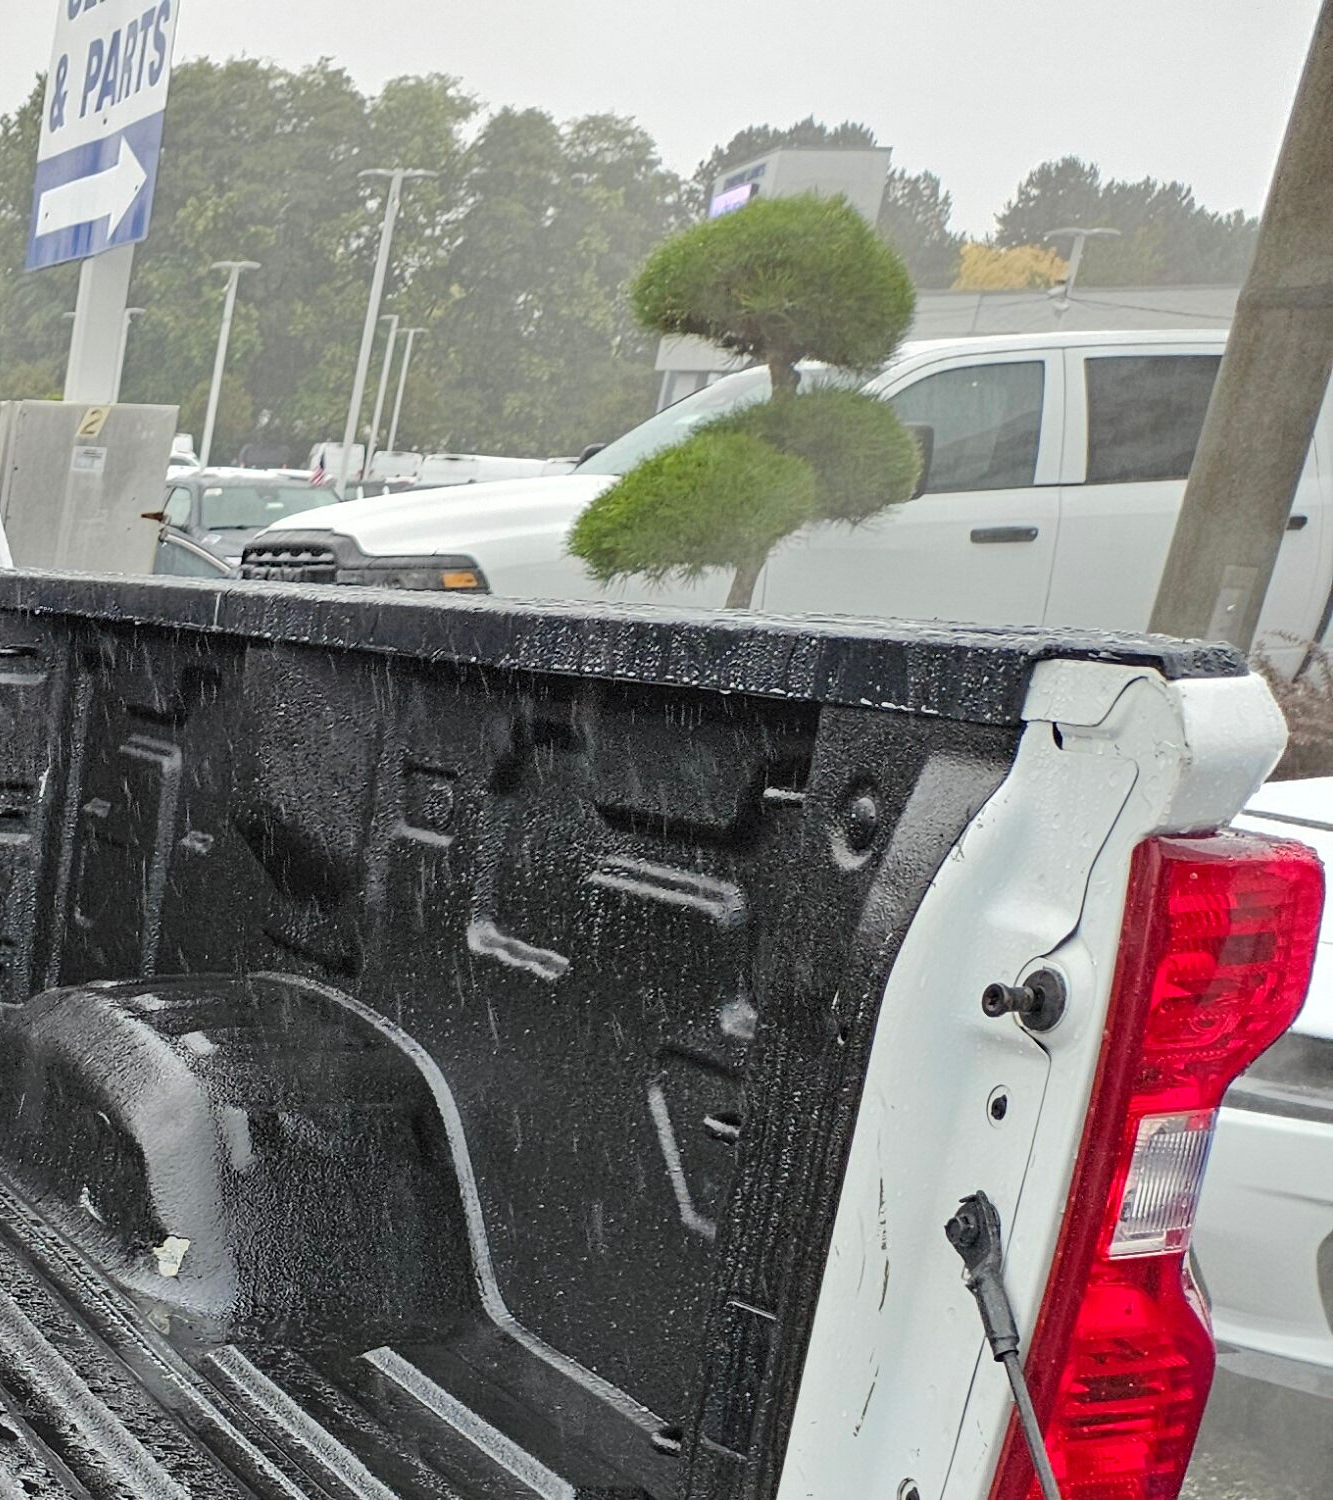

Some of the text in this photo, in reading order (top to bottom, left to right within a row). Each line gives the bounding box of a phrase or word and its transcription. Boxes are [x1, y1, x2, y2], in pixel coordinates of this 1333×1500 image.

[49, 0, 171, 133] & PARTS
[79, 409, 102, 435] 2
